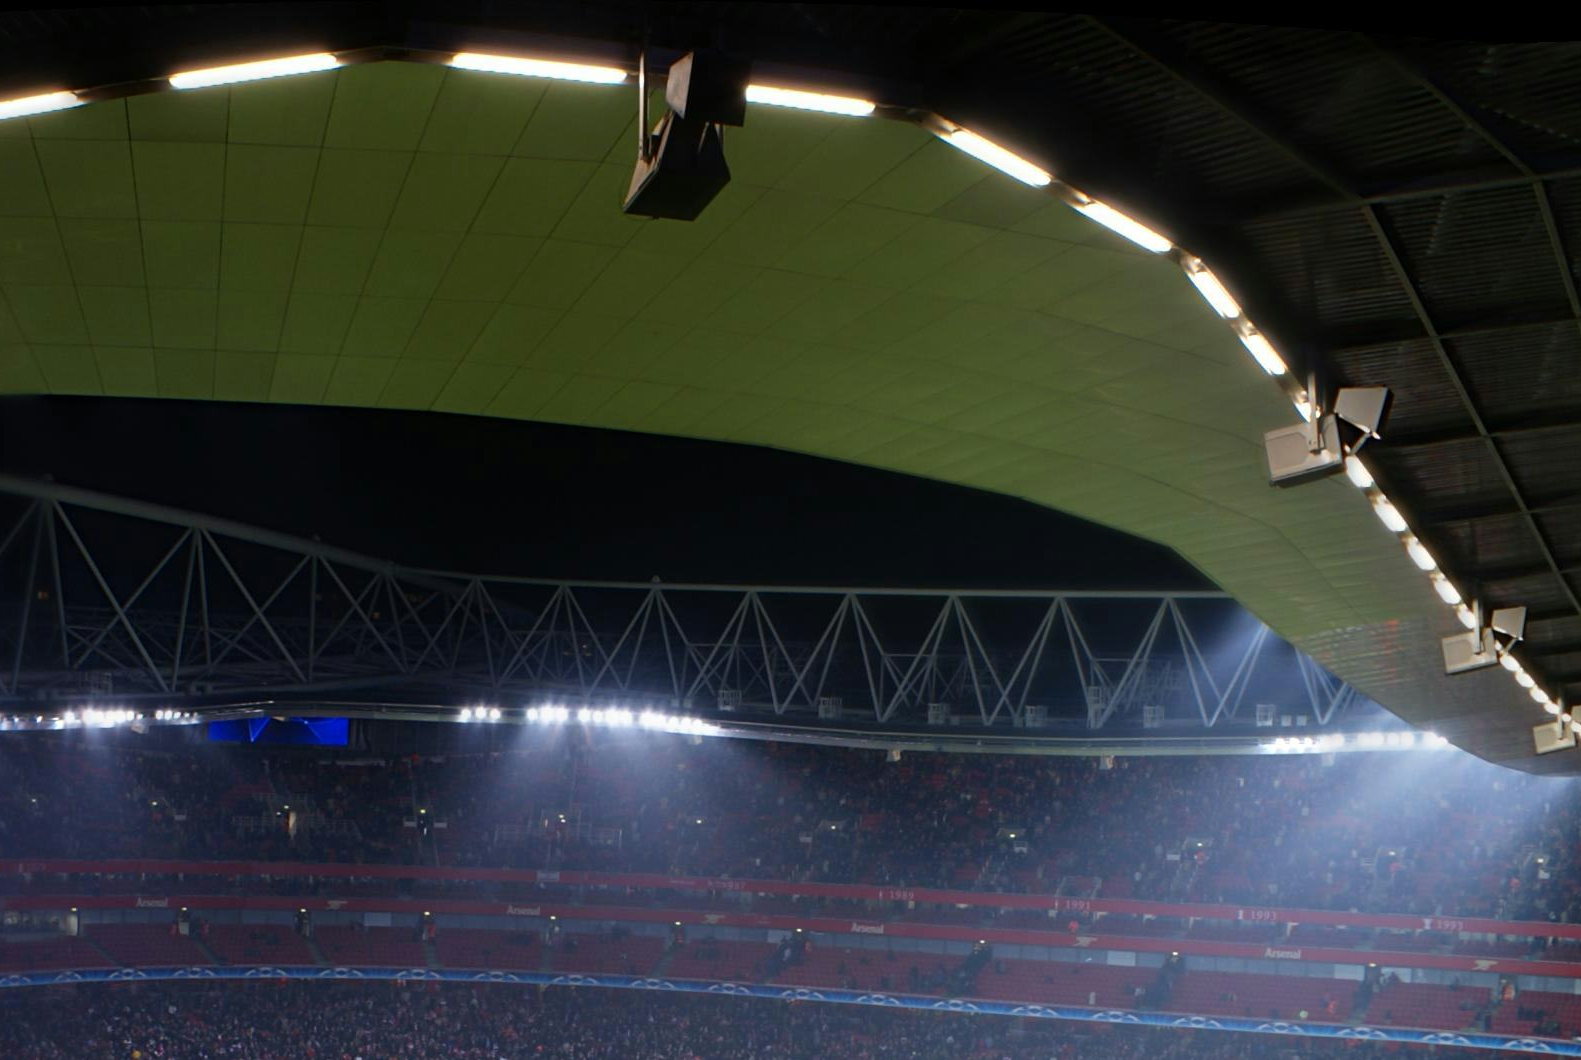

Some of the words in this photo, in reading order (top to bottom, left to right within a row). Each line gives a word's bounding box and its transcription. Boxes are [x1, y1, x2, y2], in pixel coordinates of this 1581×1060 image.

[506, 904, 541, 917] Arsenal
[850, 922, 885, 935] Arsenal
[1264, 946, 1302, 961] Arsenal
